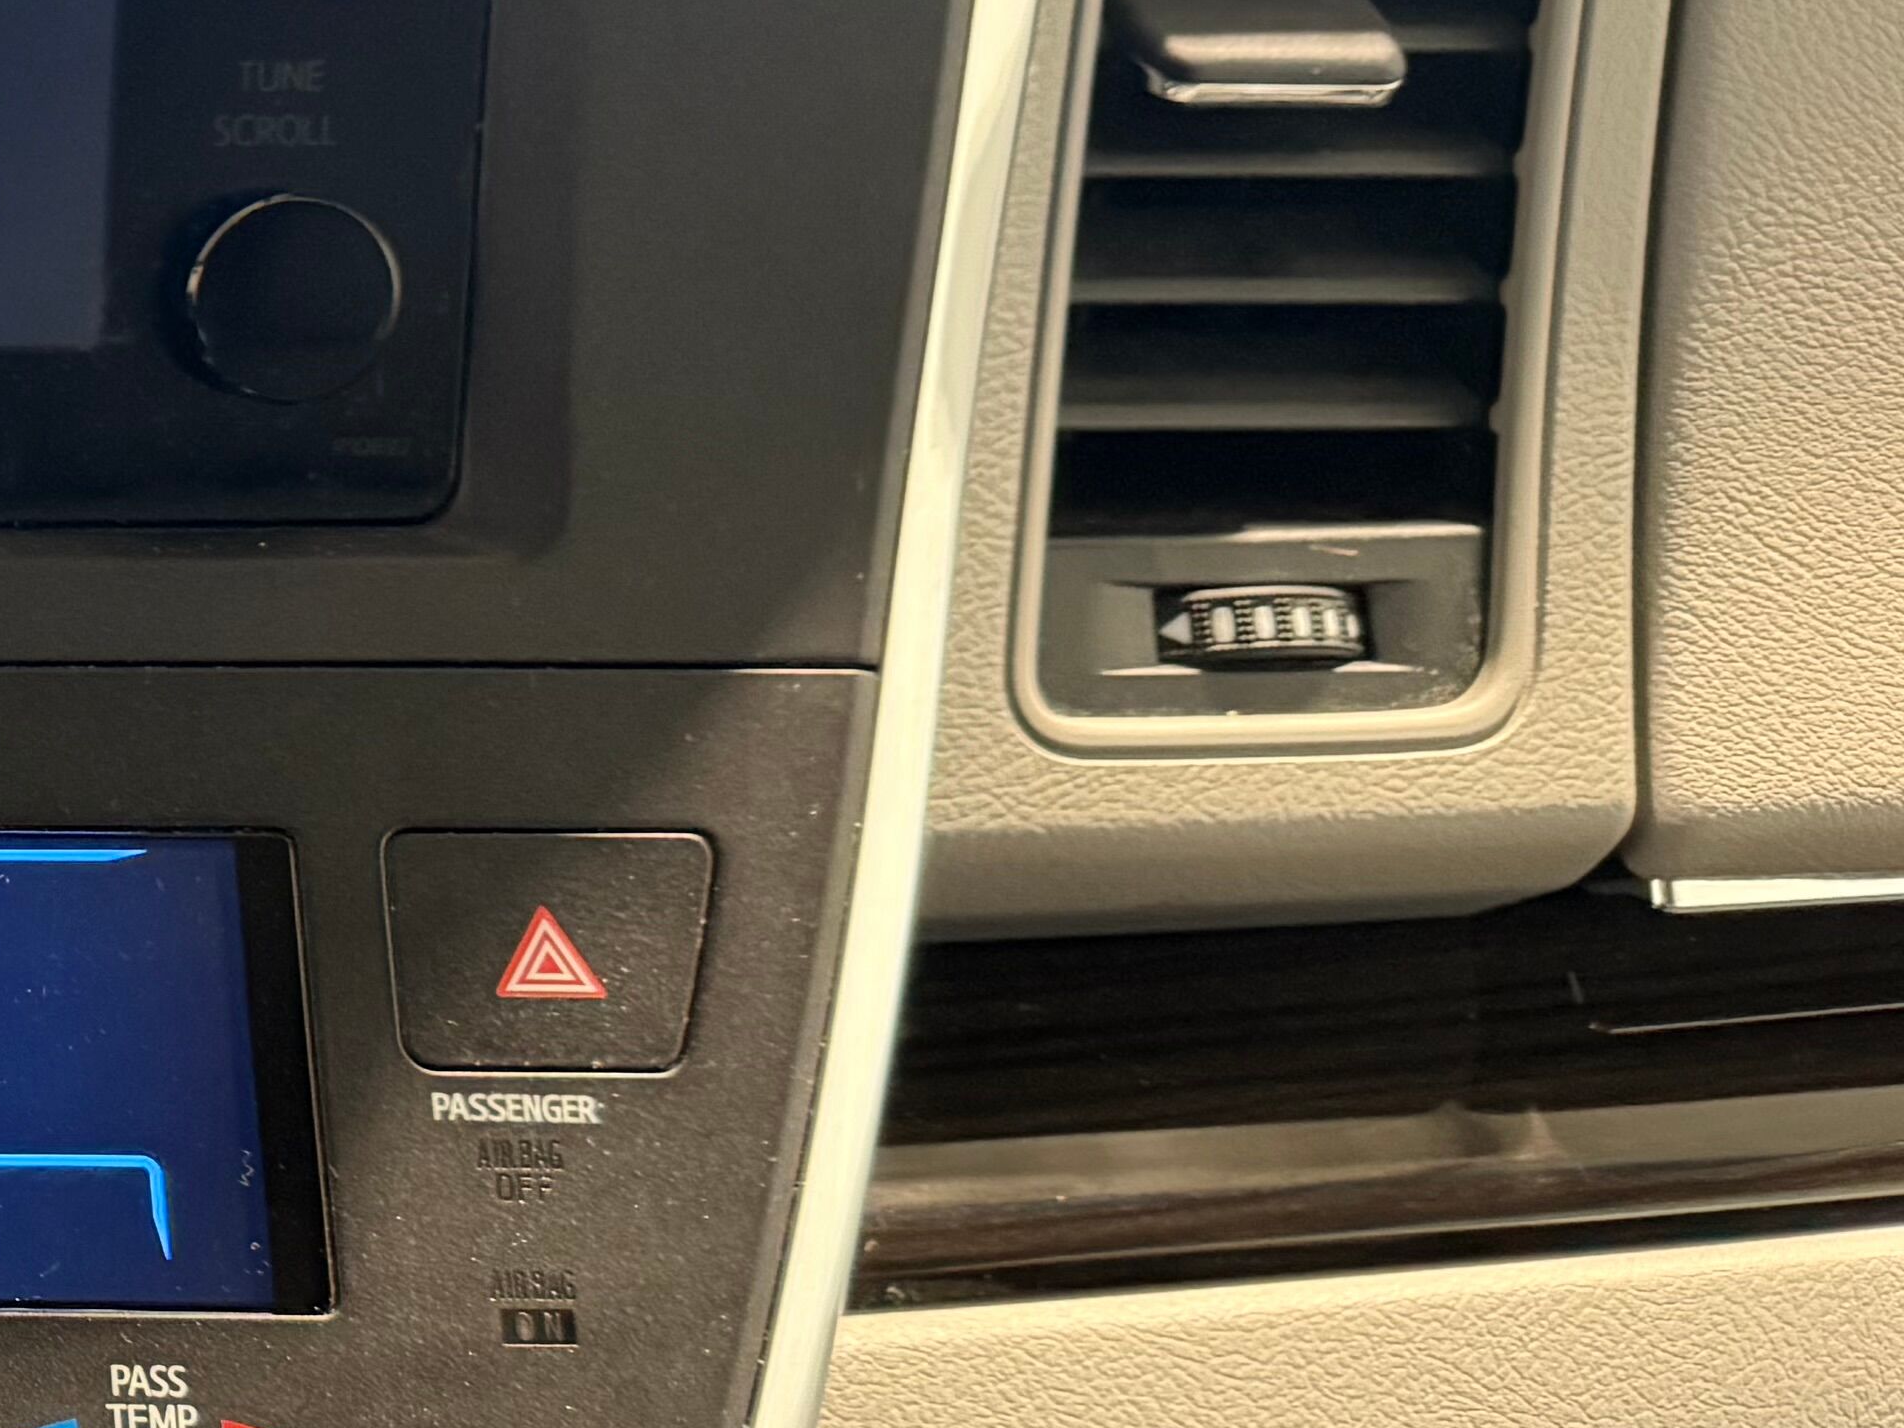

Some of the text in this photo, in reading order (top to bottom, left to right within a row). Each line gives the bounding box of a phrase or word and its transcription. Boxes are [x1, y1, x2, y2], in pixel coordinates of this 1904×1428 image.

[238, 59, 326, 93] TUNE
[212, 114, 336, 148] SCROLL
[431, 1091, 600, 1124] PASSENGER
[109, 1364, 188, 1398] PASS
